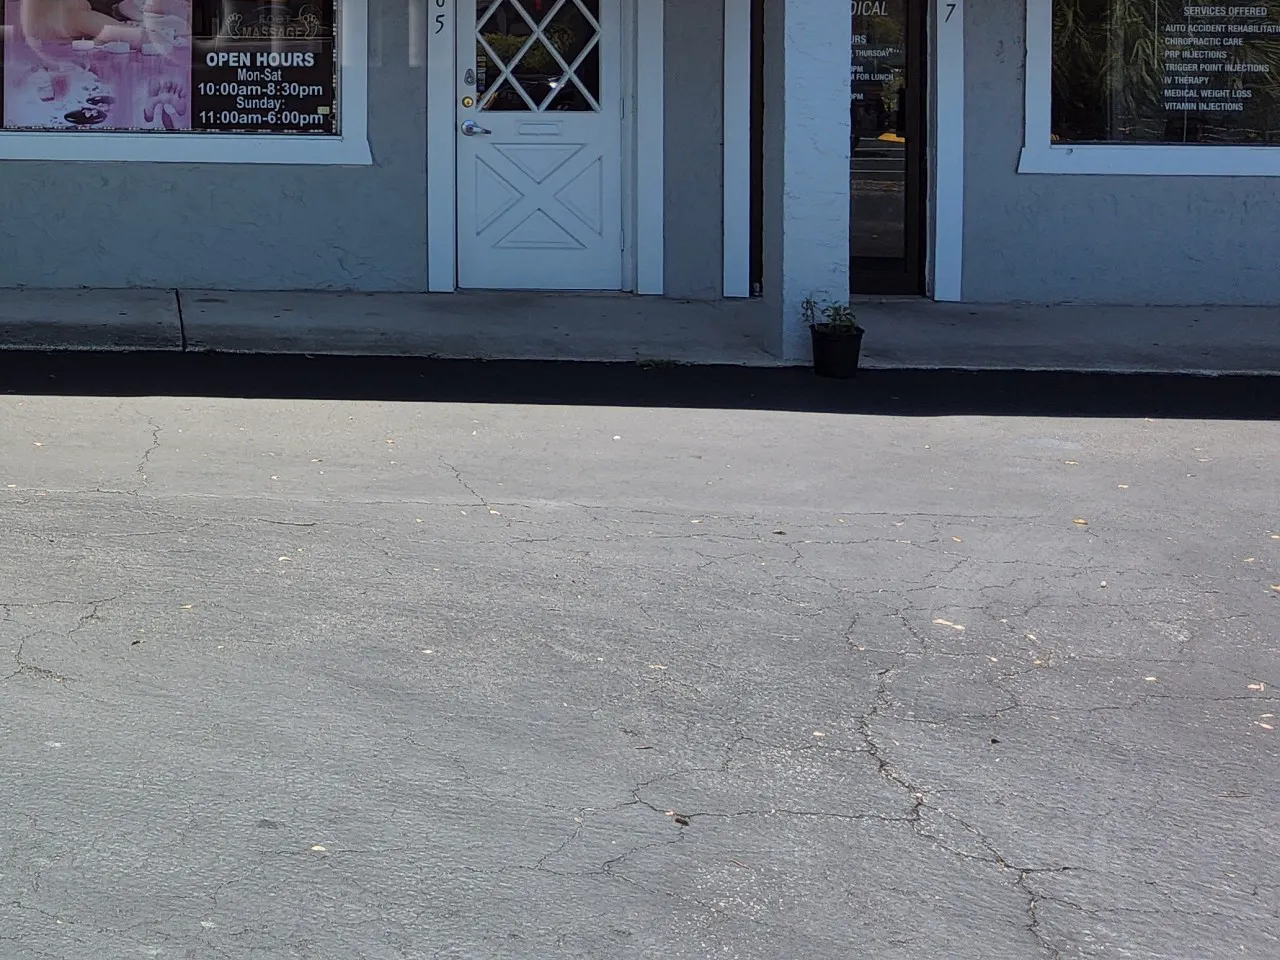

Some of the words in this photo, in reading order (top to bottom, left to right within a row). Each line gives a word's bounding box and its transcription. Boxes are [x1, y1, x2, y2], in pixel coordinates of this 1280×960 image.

[1183, 6, 1226, 16] SERVICES
[1228, 6, 1267, 16] OFFERED
[242, 27, 304, 38] MASSAGE
[1165, 24, 1186, 32] AUTO
[1187, 24, 1227, 33] ACCIDENT
[1165, 38, 1222, 46] CHIROPRACTIC
[1223, 38, 1244, 46] CARE
[855, 49, 890, 57] THURSDAY
[1165, 50, 1180, 58] PRP
[1182, 51, 1227, 59] INJECTIONS
[206, 52, 251, 67] OPEN
[256, 52, 315, 67] HOURS
[1165, 63, 1198, 71] TRIGGER
[1200, 64, 1223, 72] POINT
[1225, 64, 1269, 72] INJECTIONS
[237, 68, 282, 81] Mon-Sat
[871, 73, 894, 81] LUNCH
[1164, 76, 1172, 84] IV
[1175, 76, 1209, 84] THERAPY
[198, 82, 323, 98] 10:00am-8:30pm
[1164, 89, 1199, 97] MEDICAL
[236, 96, 285, 111] Sunday:
[1165, 102, 1197, 110] VITAMIN
[1198, 102, 1243, 111] INJECTIONS
[199, 111, 324, 126] 11:00am-6:00pm
